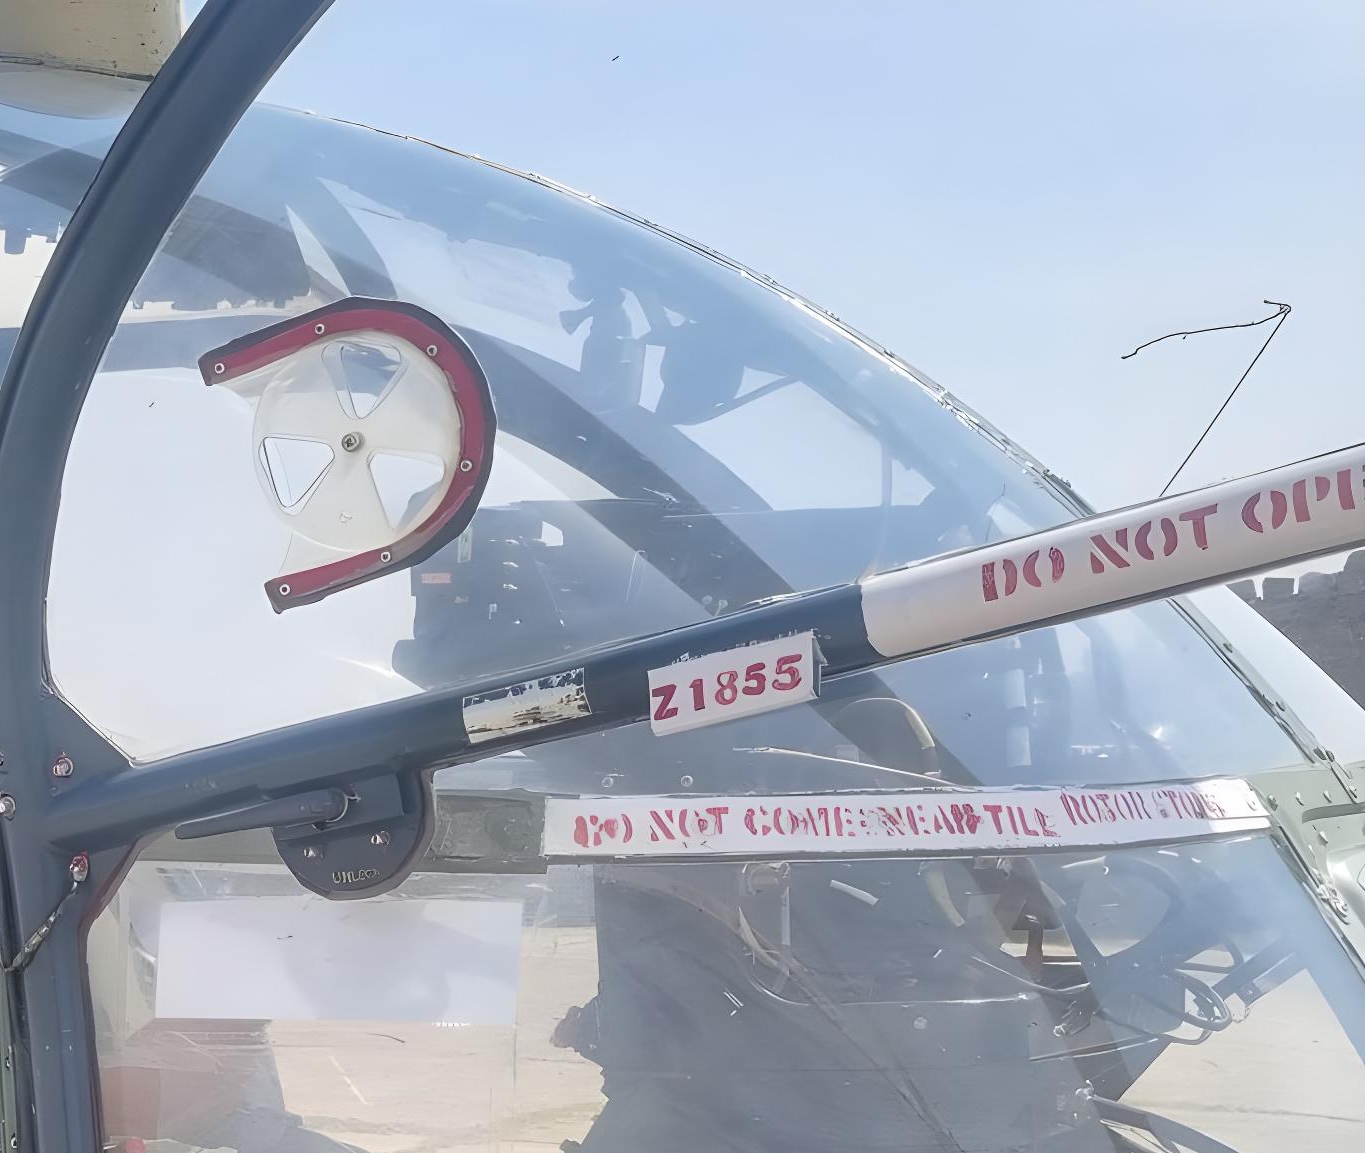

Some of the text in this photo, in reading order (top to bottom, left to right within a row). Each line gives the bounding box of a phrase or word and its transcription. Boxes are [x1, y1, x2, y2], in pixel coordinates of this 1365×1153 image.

[982, 546, 1066, 602] DO
[1089, 503, 1219, 575] NOT
[651, 653, 804, 722] Z1855
[573, 813, 633, 848] DO
[649, 805, 730, 843] NOT
[743, 805, 856, 837] COME
[982, 804, 1061, 838] TILL
[1060, 790, 1153, 826] ROTOR
